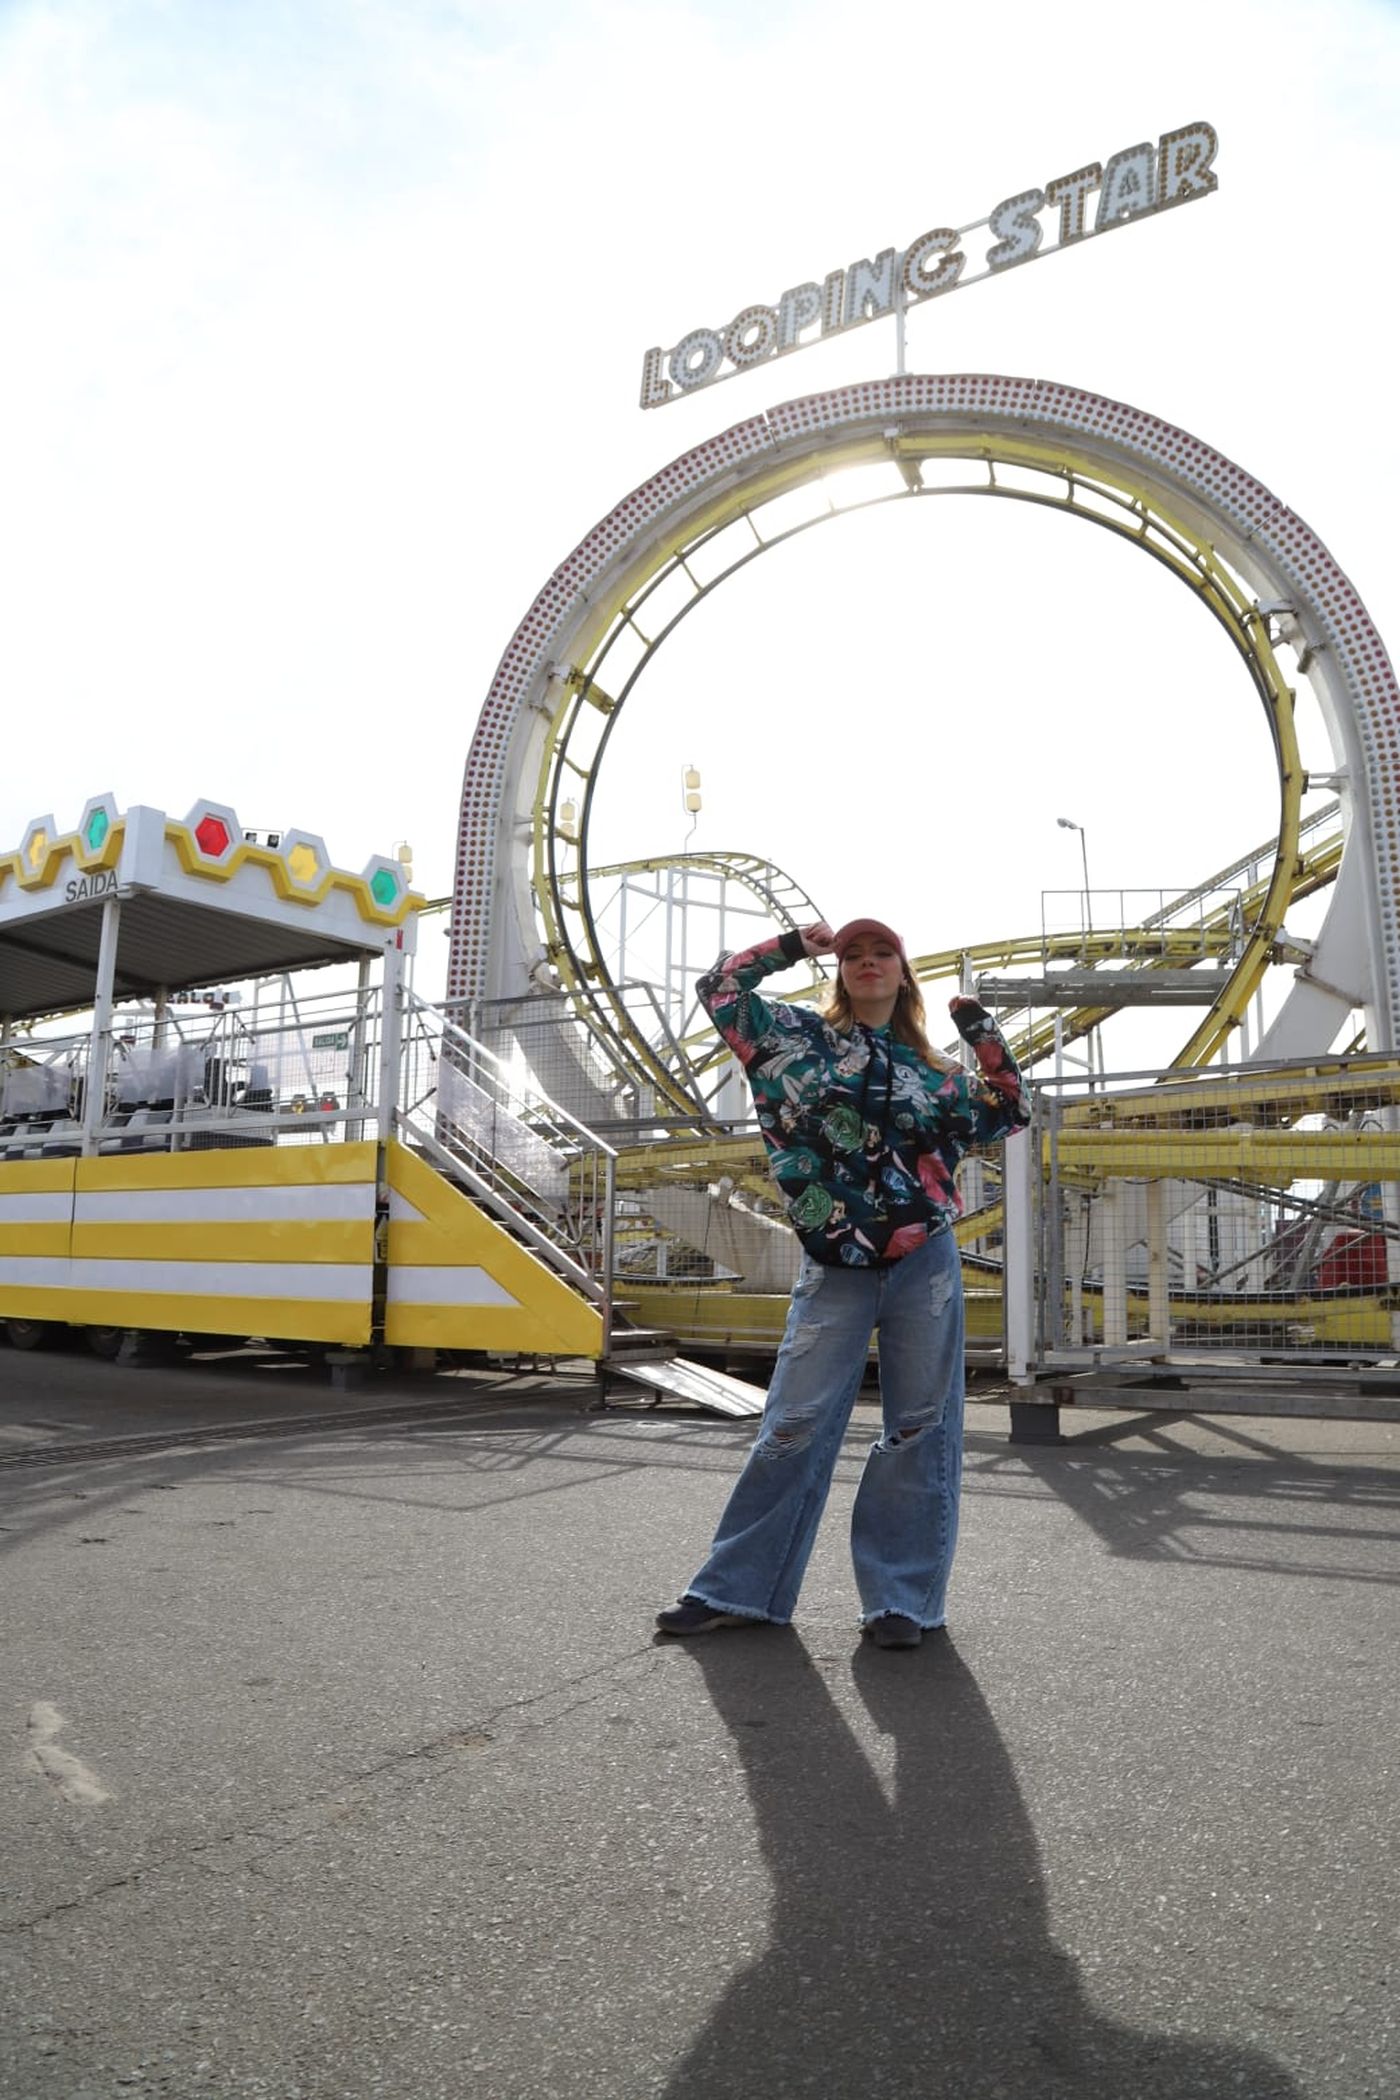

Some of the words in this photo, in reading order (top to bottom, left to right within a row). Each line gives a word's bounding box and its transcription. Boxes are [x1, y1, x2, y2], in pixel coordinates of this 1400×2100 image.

[639, 228, 966, 407] LOOPING
[986, 121, 1218, 271] STAR
[66, 870, 118, 902] SAIDA
